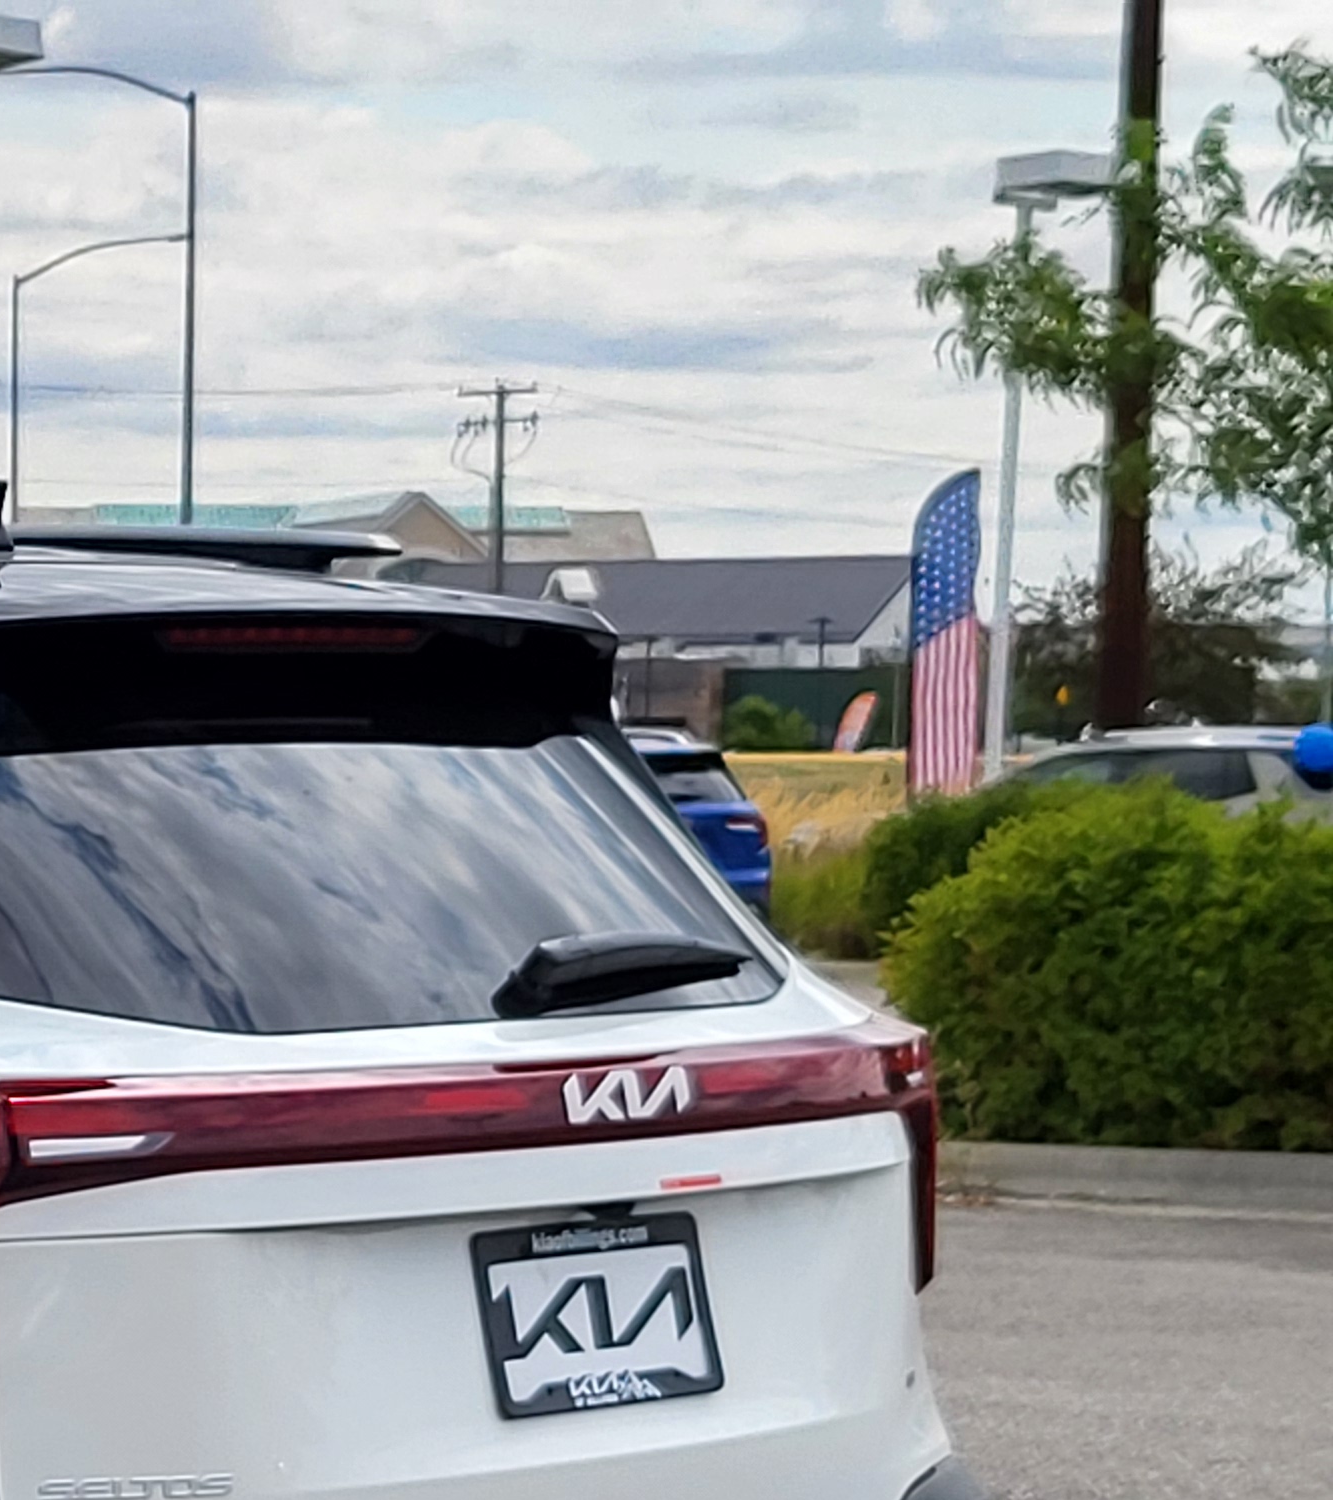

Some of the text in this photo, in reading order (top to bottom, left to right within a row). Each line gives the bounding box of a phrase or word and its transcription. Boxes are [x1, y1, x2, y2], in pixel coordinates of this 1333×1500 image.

[563, 1065, 690, 1125] KIA
[487, 1265, 694, 1361] KIA
[568, 1371, 618, 1397] KIA
